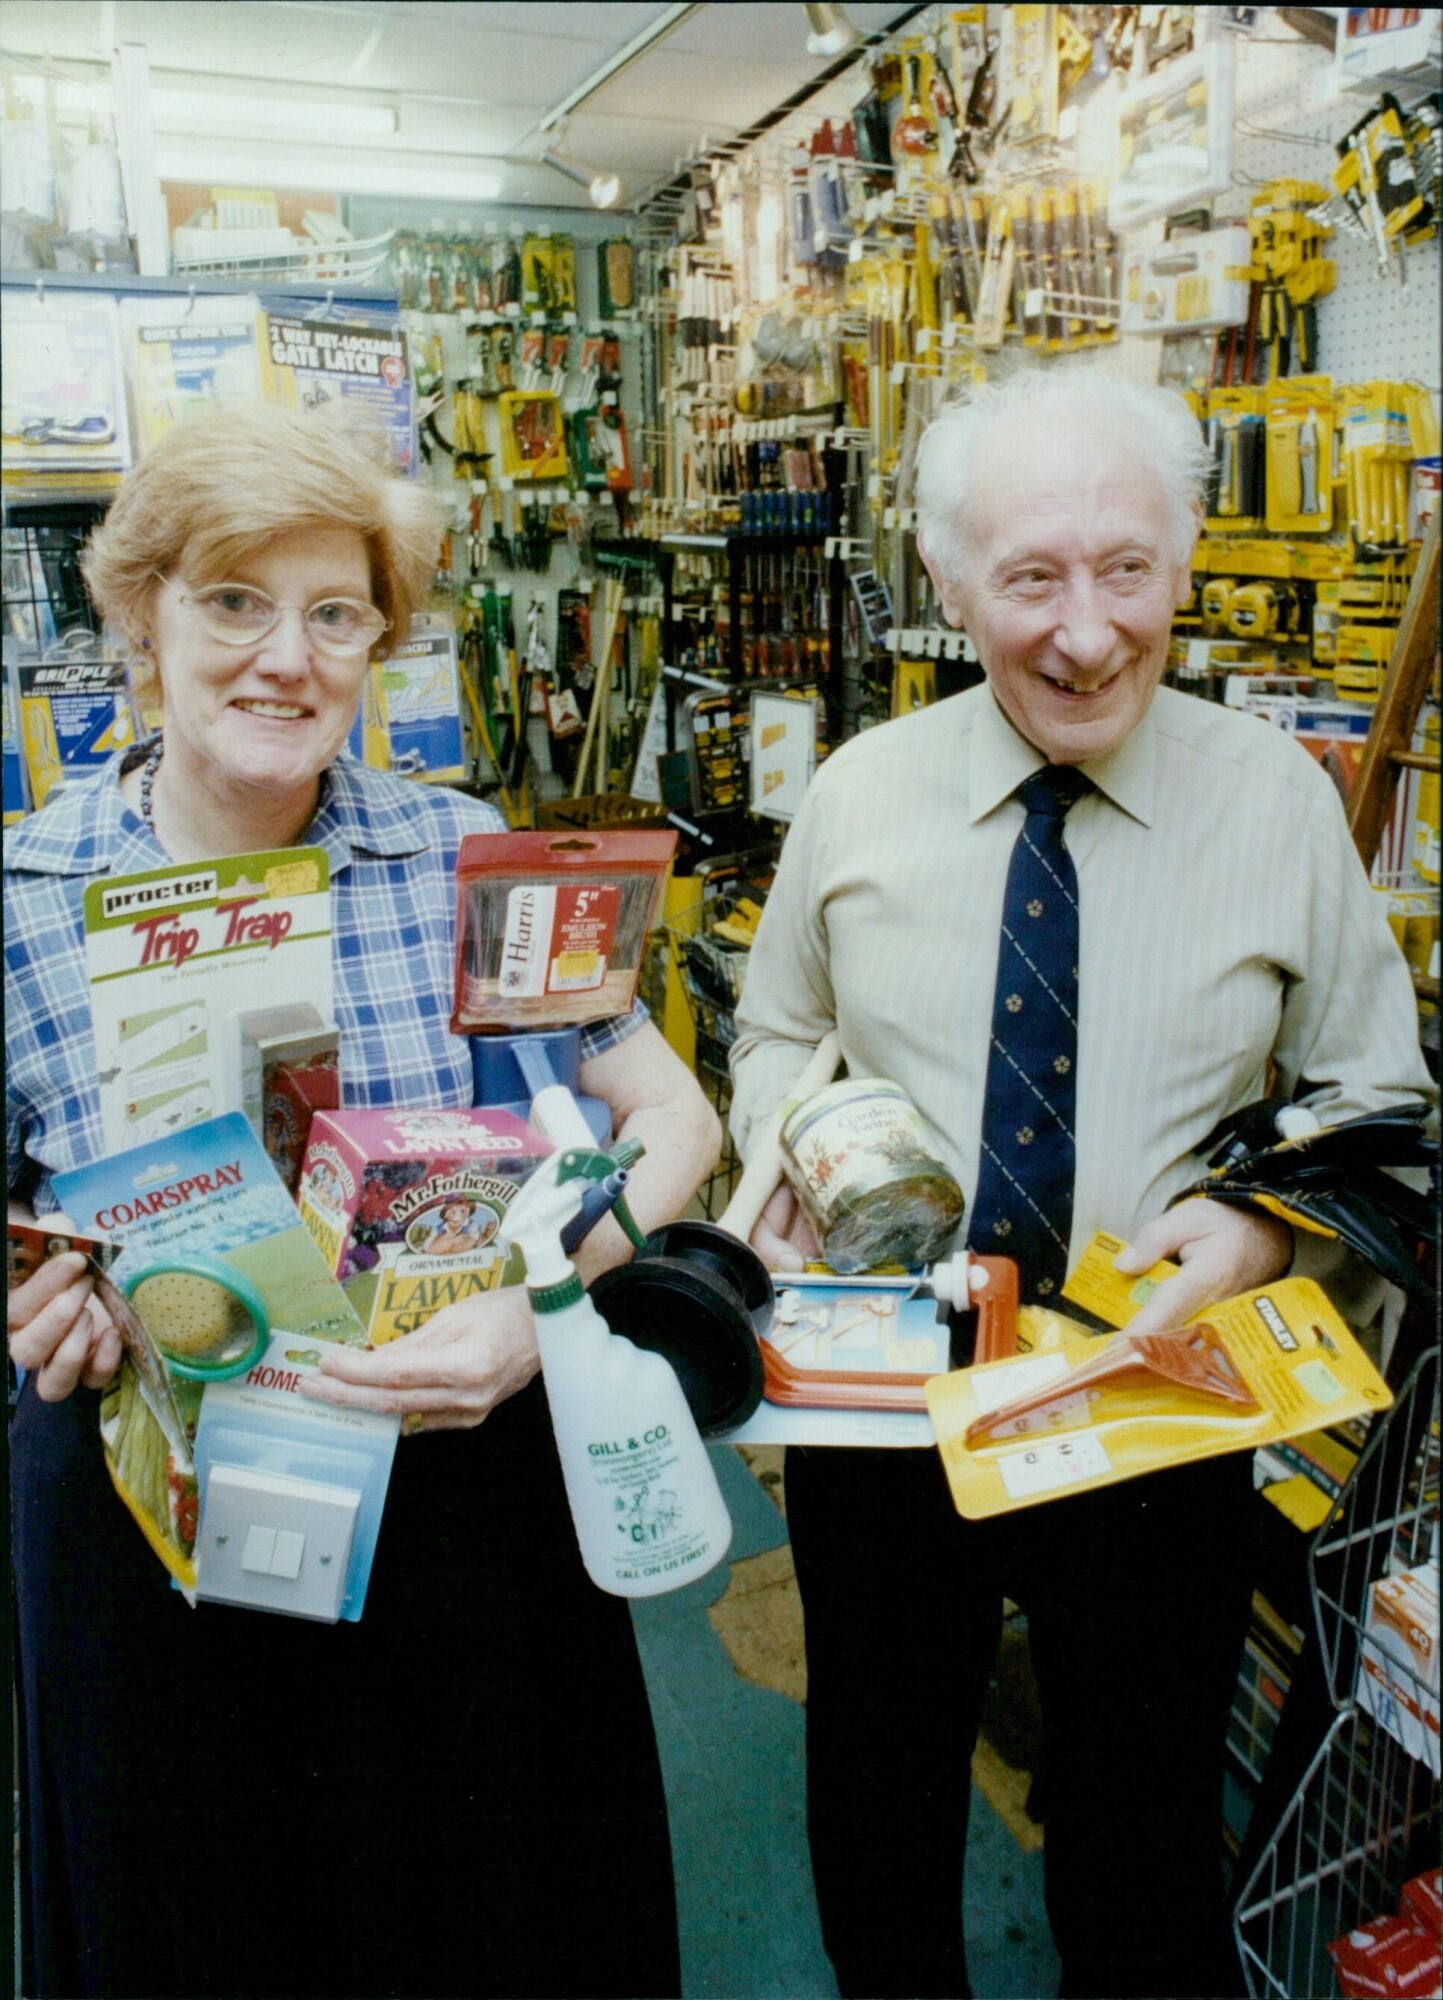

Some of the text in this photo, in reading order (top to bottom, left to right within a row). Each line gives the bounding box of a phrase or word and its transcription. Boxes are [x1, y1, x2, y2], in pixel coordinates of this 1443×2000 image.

[144, 327, 178, 342] QUICK
[271, 326, 402, 357] 2 WAY KEY-LOCKABLE
[272, 342, 379, 374] GATE LATCH
[33, 665, 114, 684] GRIPPLE
[105, 877, 215, 913] procter
[574, 891, 599, 917] 5"
[132, 897, 293, 969] Trip Trap
[507, 892, 534, 962] Harris
[119, 1020, 127, 1032] 1
[127, 1103, 138, 1115] 2
[384, 1136, 523, 1154] LAWN SEED
[95, 1160, 245, 1231] COARSPRAY
[409, 1254, 484, 1271] ORNAMENTAL
[382, 1269, 496, 1313] LAWN
[393, 1309, 432, 1337] SE
[1254, 1297, 1297, 1350] STANLEY
[246, 1365, 303, 1394] HOME
[588, 1441, 624, 1456] GILL
[627, 1437, 639, 1450] &
[616, 1569, 640, 1579] CALL
[643, 1565, 661, 1577] ON
[663, 1560, 679, 1571] US
